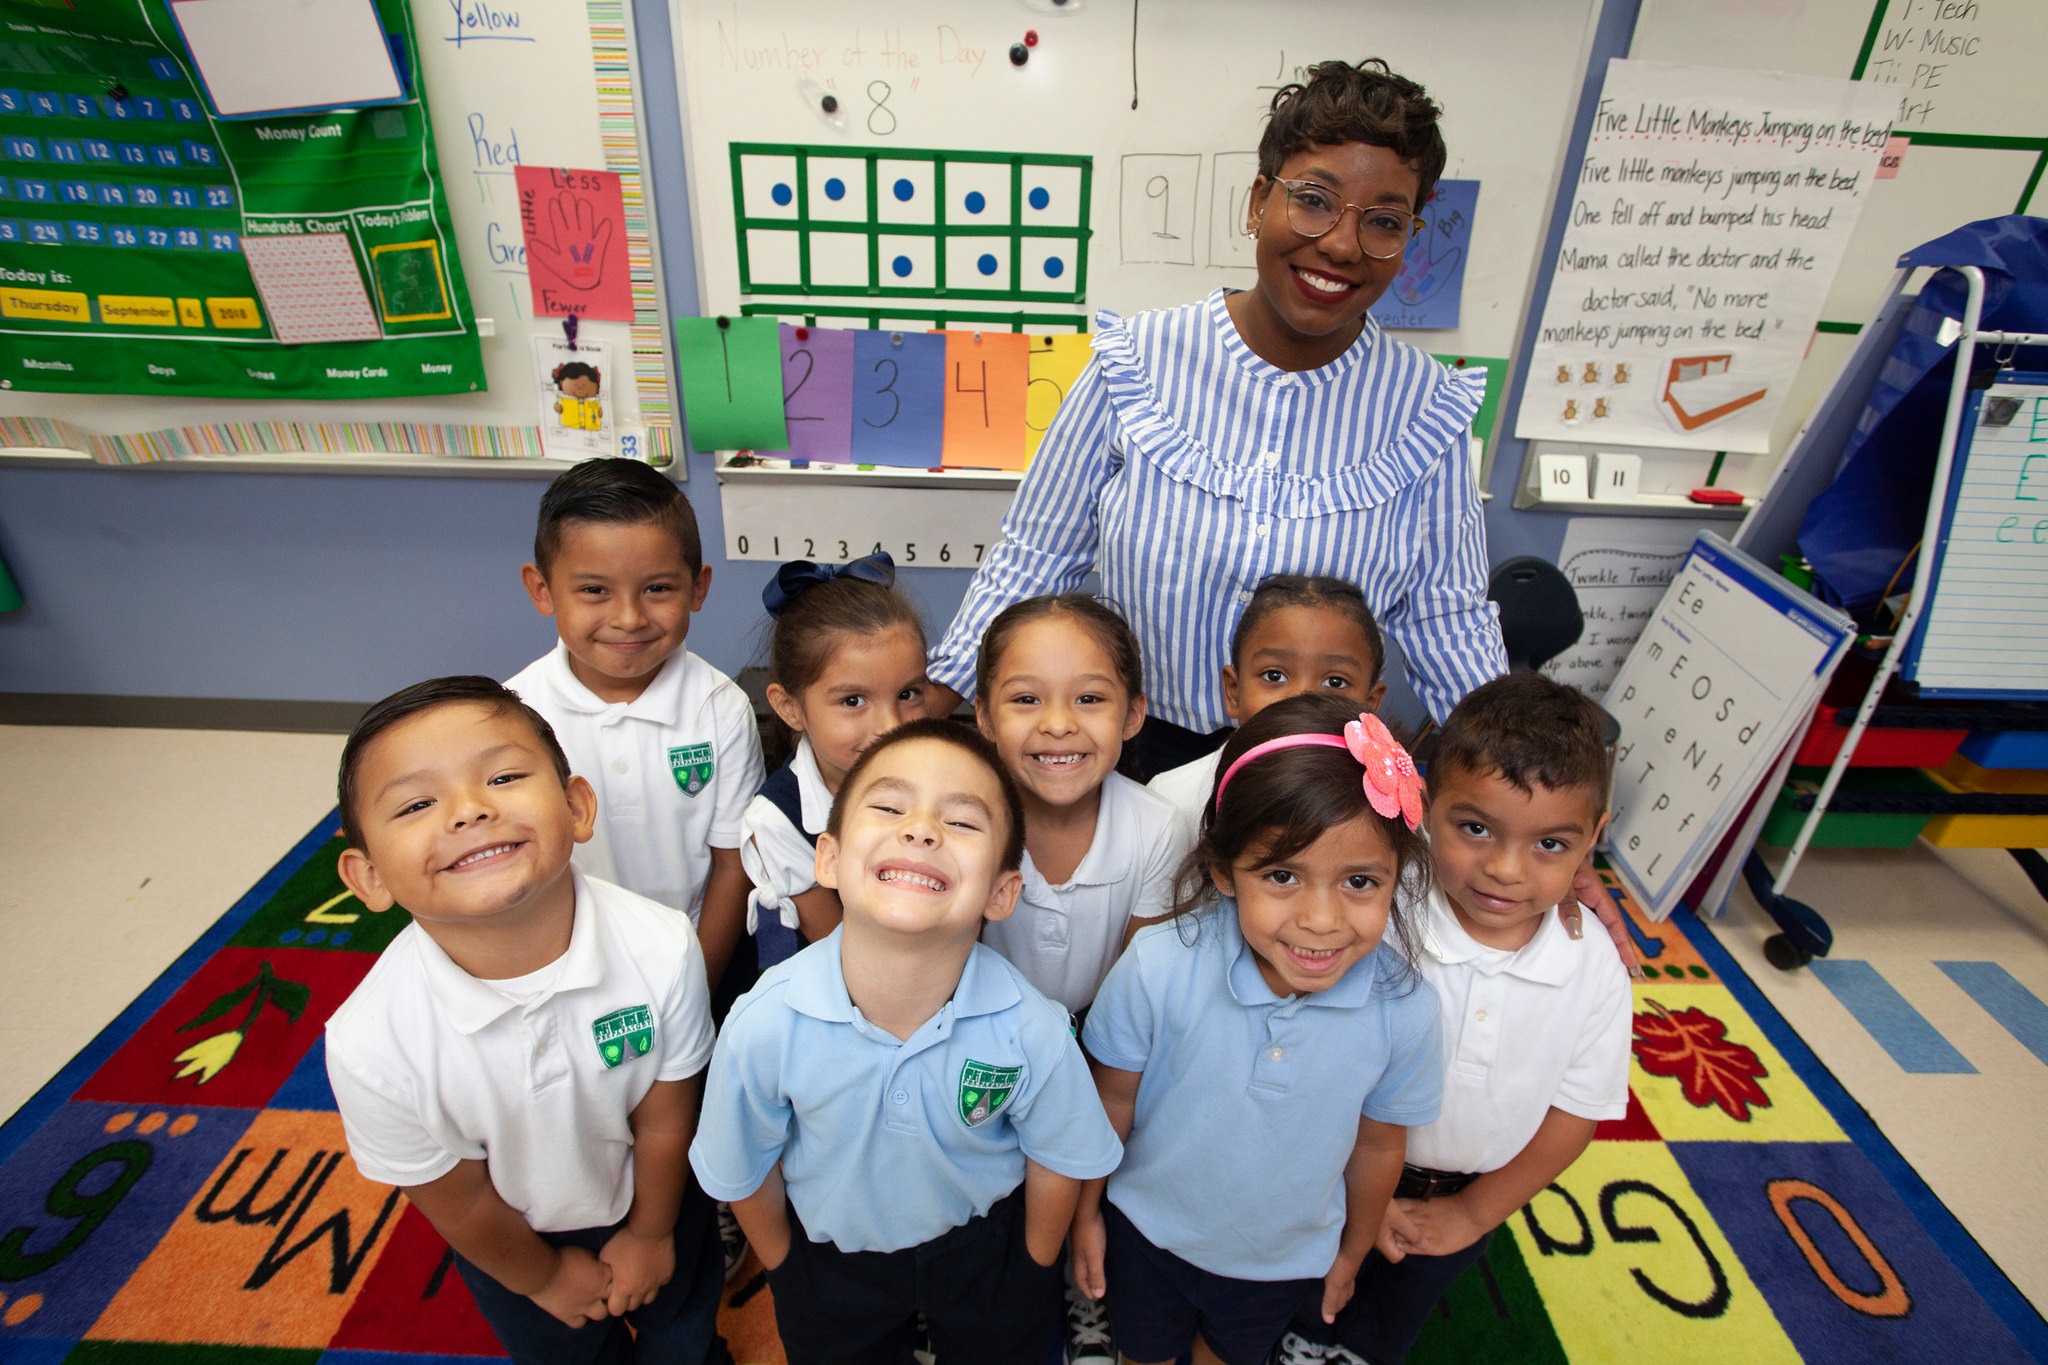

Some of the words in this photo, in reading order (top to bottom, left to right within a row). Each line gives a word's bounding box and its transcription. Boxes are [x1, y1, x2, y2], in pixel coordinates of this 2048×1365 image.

[450, 0, 519, 49] Yellow
[718, 20, 826, 72] Number
[842, 27, 868, 67] of
[881, 27, 919, 70] the
[937, 24, 986, 78] Day
[1919, 28, 1981, 57] Music
[160, 62, 171, 77] 1
[1911, 63, 1949, 90] PE
[38, 97, 54, 113] 4
[77, 99, 88, 115] 5
[115, 102, 126, 118] 6
[142, 101, 153, 117] 7
[180, 103, 192, 120] 8
[254, 127, 306, 141] Money
[308, 123, 342, 139] Count
[468, 112, 521, 166] Red
[1596, 99, 1628, 133] Five
[1635, 103, 1682, 135] Little
[1687, 109, 1751, 146] Monkeys
[1754, 111, 1814, 153] Jumping
[1816, 124, 1836, 140] on
[1840, 120, 1862, 144] the
[1863, 120, 1893, 148] bed
[12, 142, 35, 158] 10
[54, 145, 74, 161] 11
[89, 142, 111, 158] 12
[125, 147, 145, 163] 13
[159, 149, 176, 165] 14
[191, 145, 211, 163] 15
[550, 168, 601, 190] Less
[1581, 157, 1612, 185] Five
[1618, 157, 1655, 182] little
[1661, 159, 1723, 193] monkeys
[1722, 167, 1781, 200] jumping
[1783, 171, 1800, 186] on
[1805, 167, 1825, 189] the
[1829, 169, 1860, 197] bed,
[24, 183, 46, 199] 17
[66, 185, 89, 200] 18
[103, 188, 124, 204] 19
[135, 188, 158, 204] 20
[173, 190, 191, 205] 21
[208, 190, 229, 206] 22
[247, 219, 303, 233] Hundreds
[305, 218, 349, 233] Chart
[1438, 209, 1466, 239] Big
[1574, 201, 1601, 227] One
[1611, 198, 1633, 225] fell
[1638, 200, 1666, 226] off
[1665, 206, 1693, 226] and
[1699, 204, 1758, 232] bumped
[1762, 207, 1786, 227] his
[0, 224, 14, 239] 3
[34, 223, 58, 240] 24
[77, 224, 100, 240] 25
[114, 230, 137, 246] 26
[148, 229, 169, 246] 27
[178, 230, 199, 245] 28
[212, 234, 233, 250] 29
[1559, 249, 1608, 271] Mama
[1617, 244, 1663, 269] called
[1667, 246, 1693, 268] the
[1696, 245, 1752, 269] doctor
[1750, 249, 1782, 270] and
[1786, 248, 1815, 271] the
[50, 270, 72, 284] is:
[10, 297, 79, 316] Thursday
[104, 304, 171, 319] September
[542, 289, 588, 314] Fewer
[1582, 288, 1634, 312] doctor
[1635, 284, 1677, 311] said,
[1724, 291, 1768, 308] more
[1542, 320, 1610, 347] monkeys
[1610, 321, 1671, 349] jumping
[1675, 326, 1693, 341] on
[1701, 320, 1727, 339] the
[23, 358, 74, 372] Months
[147, 363, 177, 377] Days
[326, 367, 360, 380] Money
[361, 366, 389, 378] Cards
[421, 363, 453, 375] Money
[721, 331, 733, 403] 1
[784, 349, 825, 421] 2
[863, 359, 900, 428] 3
[956, 361, 989, 428] 4
[1025, 349, 1064, 431] 5
[621, 435, 638, 458] 33
[1553, 469, 1570, 484] 10
[1613, 471, 1625, 487] 11
[2015, 454, 2047, 501] E
[1996, 516, 2019, 543] e
[737, 535, 749, 554] 0
[773, 536, 780, 555] 1
[804, 539, 815, 557] 2
[838, 541, 849, 559] 3
[906, 543, 916, 562] 5
[940, 544, 951, 562] 6
[974, 544, 985, 562] 7
[1569, 566, 1619, 584] Twinkle
[1630, 566, 1674, 584] Twinkl
[1588, 632, 1601, 645] I
[1569, 656, 1604, 668] above
[1647, 641, 1664, 662] m
[1670, 655, 1689, 680] E
[1691, 675, 1712, 701] O
[1715, 697, 1735, 722] S
[1738, 721, 1761, 746] d
[1619, 684, 1636, 703] p
[1643, 705, 1656, 719] r
[1664, 727, 1677, 744] e
[1682, 741, 1708, 771] N
[1707, 763, 1725, 791] h
[1638, 762, 1655, 784] T
[1651, 792, 1670, 812] p
[1677, 812, 1695, 833] f
[1611, 805, 1625, 823] i
[1628, 834, 1641, 851] e
[1646, 853, 1663, 876] L
